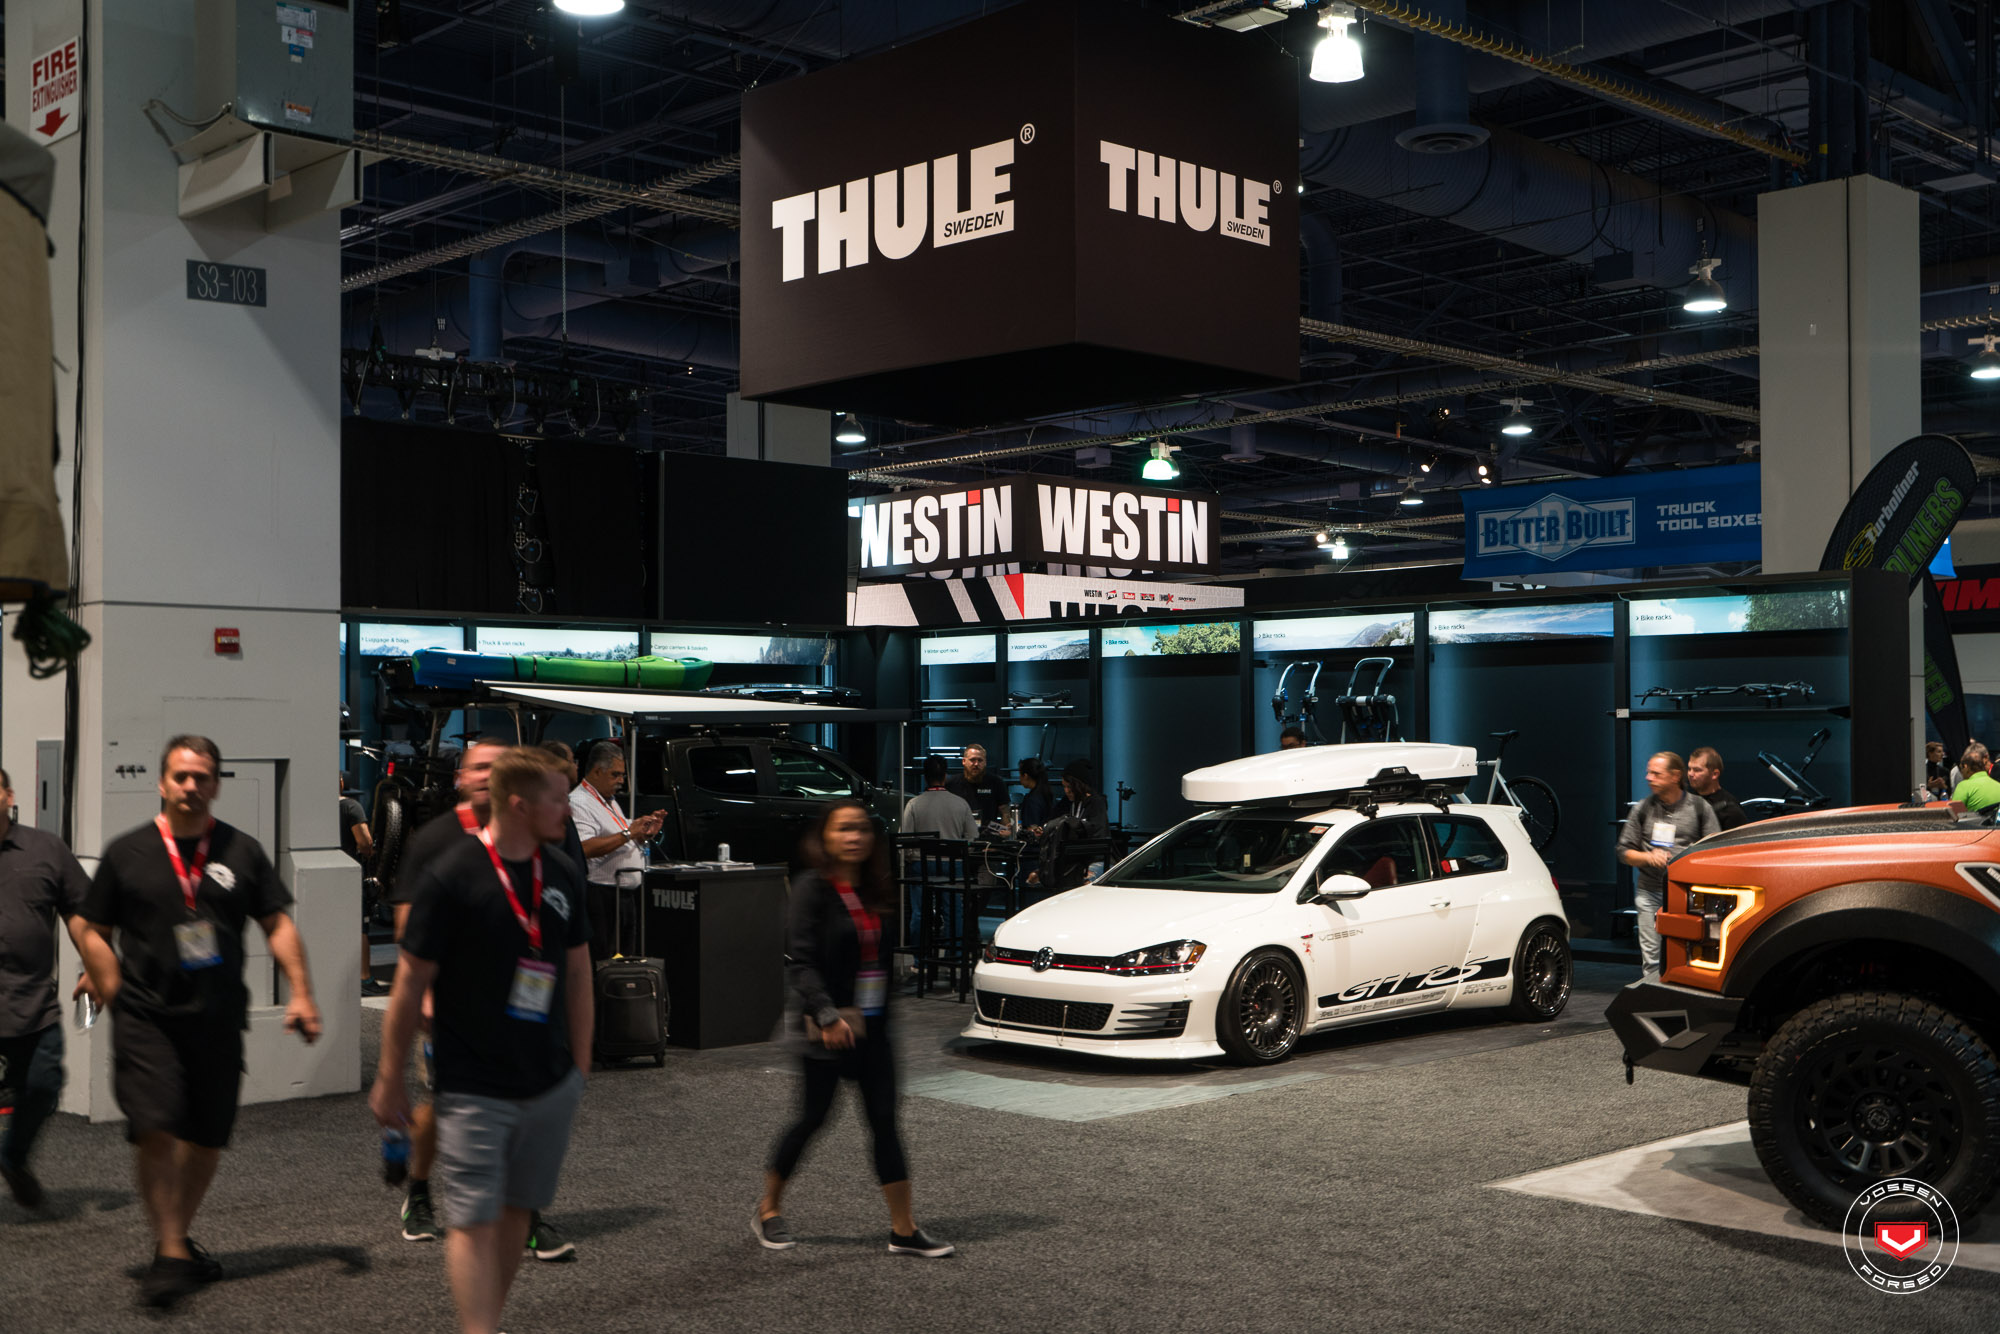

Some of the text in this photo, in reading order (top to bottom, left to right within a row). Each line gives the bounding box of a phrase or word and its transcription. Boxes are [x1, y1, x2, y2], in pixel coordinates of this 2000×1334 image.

[33, 41, 77, 88] FIRE
[32, 69, 77, 113] EXTINGUISHER
[1100, 140, 1271, 247] THULE
[772, 138, 1015, 282] THULE
[943, 210, 1004, 240] SWEDEN
[1226, 220, 1265, 240] SWEDEN
[197, 264, 257, 304] S3-103
[1656, 500, 1717, 518] TRUCK
[1483, 508, 1630, 549] BETTER BUILT
[1656, 518, 1704, 532] TOOL
[1640, 613, 1672, 622] Bike racks
[652, 888, 696, 911] THULE
[1318, 927, 1365, 942] VOSSEN
